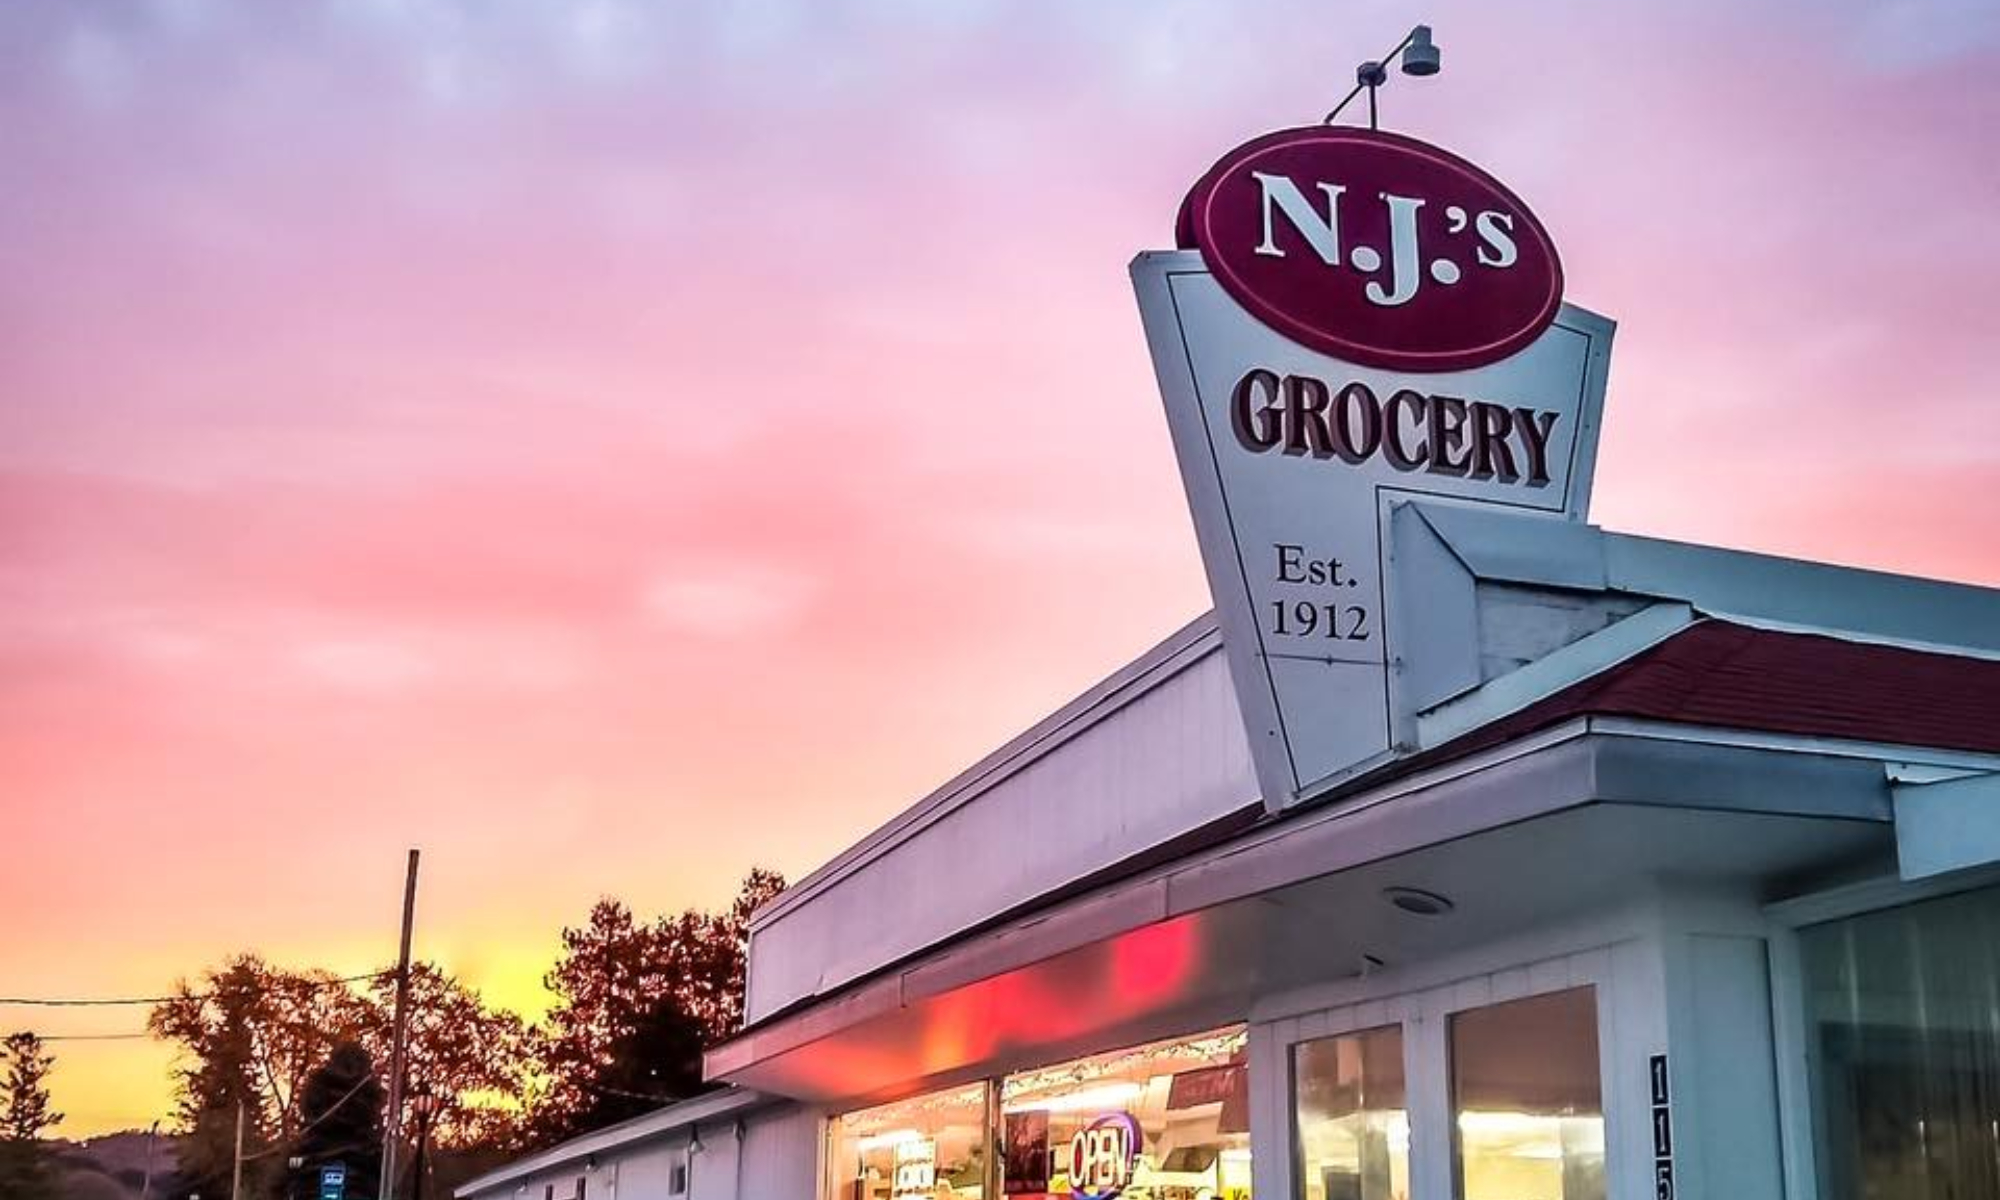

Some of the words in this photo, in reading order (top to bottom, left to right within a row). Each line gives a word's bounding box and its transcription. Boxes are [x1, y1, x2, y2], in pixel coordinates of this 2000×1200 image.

[1251, 170, 1519, 307] N.J.'s
[1230, 368, 1559, 488] GROCERY
[1273, 543, 1358, 588] Est.
[1271, 599, 1370, 641] 1912
[1069, 1127, 1129, 1187] OPEN
